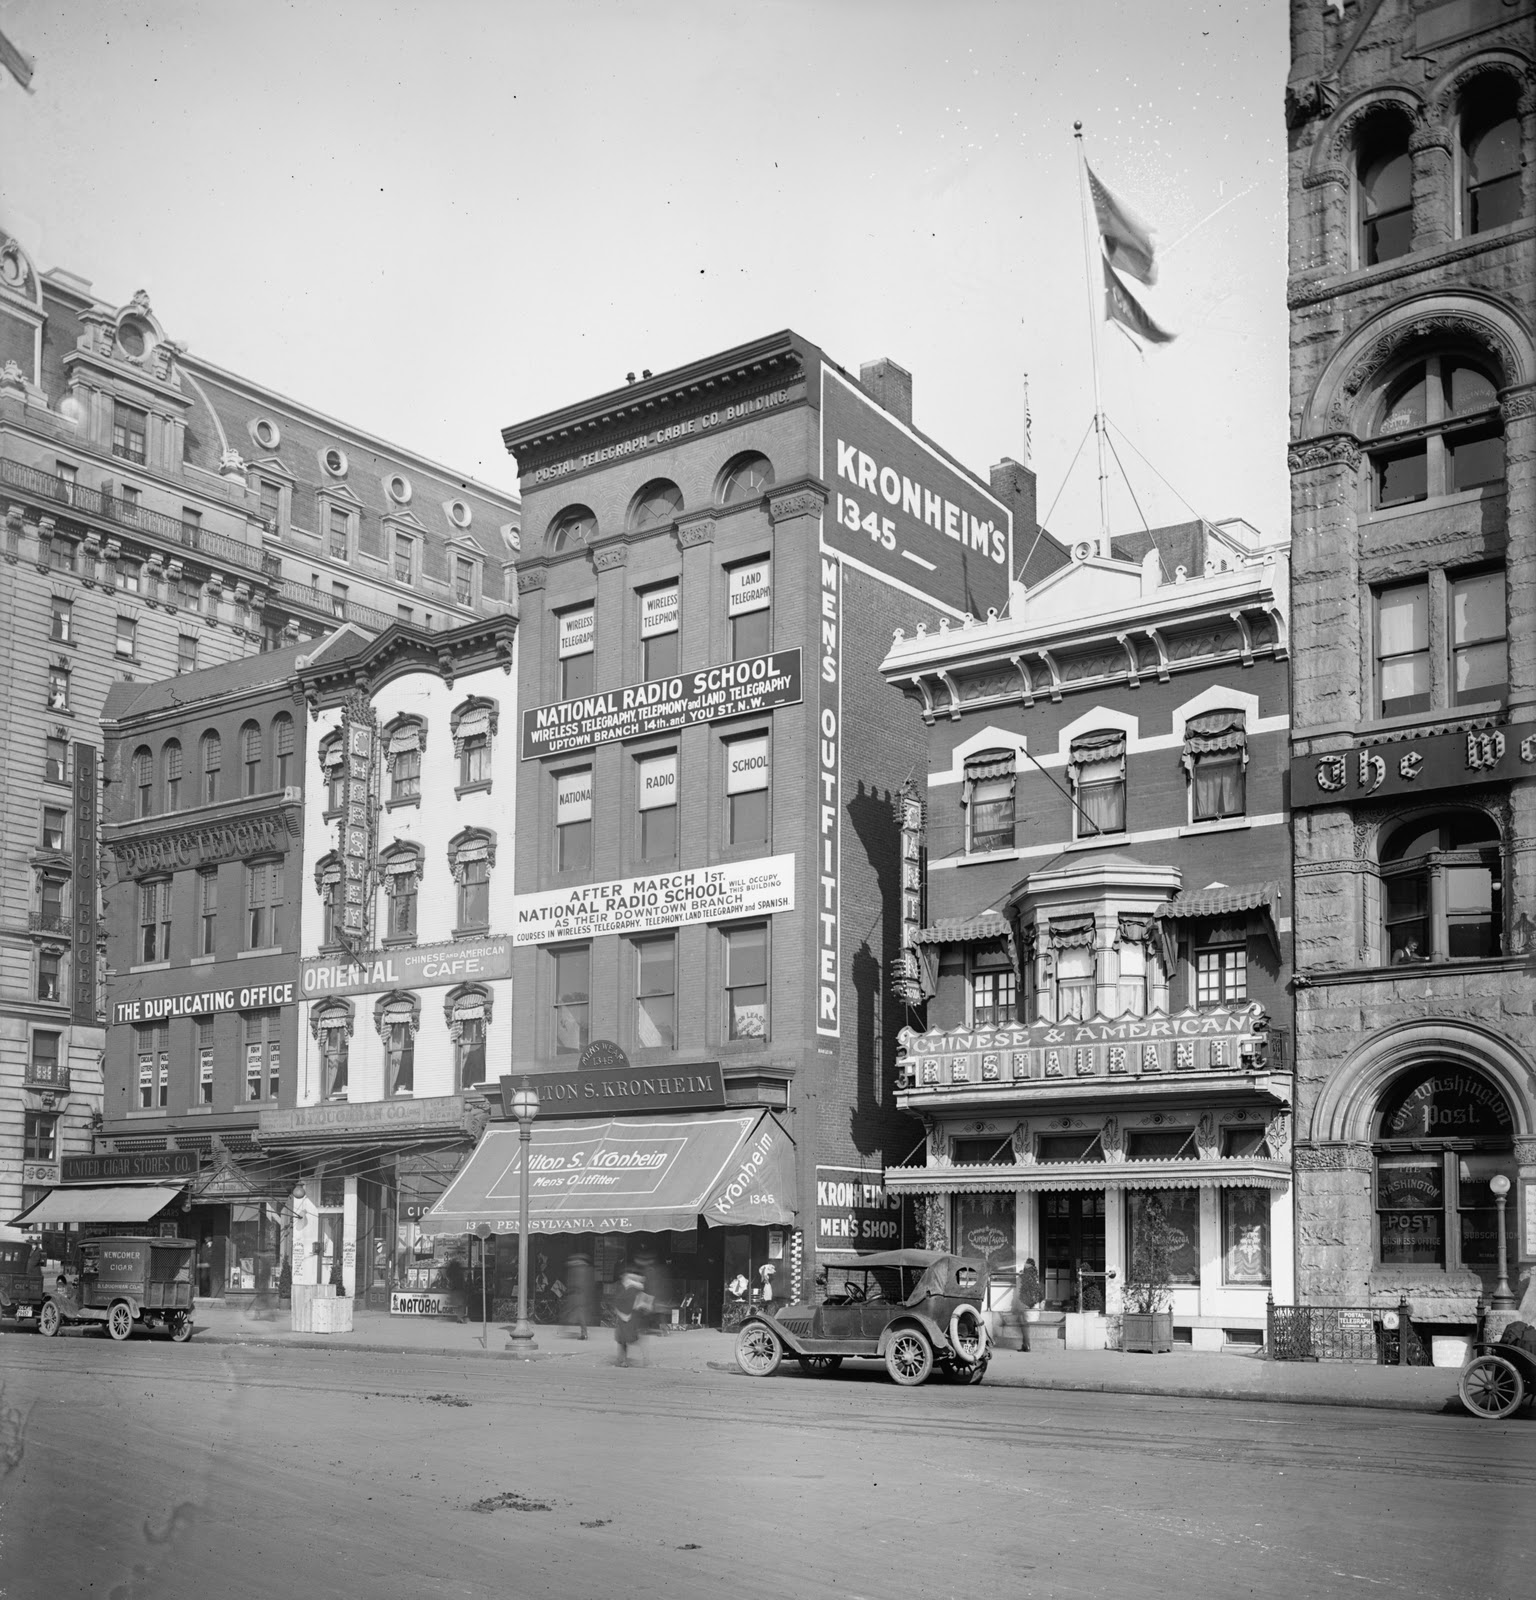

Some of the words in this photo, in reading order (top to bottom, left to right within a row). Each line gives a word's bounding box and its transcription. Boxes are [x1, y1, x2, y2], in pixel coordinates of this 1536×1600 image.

[535, 459, 576, 484] POSTAL
[702, 411, 721, 428] CO.
[837, 438, 1006, 564] KRONHEIM'S
[837, 492, 896, 550] 1345
[741, 571, 761, 588] LAND
[647, 593, 678, 611] WIRELESS
[566, 615, 593, 632] WIRELESS
[821, 558, 837, 682] MEN'S
[536, 695, 617, 729] NATIONAL
[623, 679, 683, 710] RADIO
[693, 656, 781, 694] SCHOOL
[531, 723, 578, 744] WIRELESS
[637, 698, 688, 722] TELEPHONY
[688, 697, 701, 711] and
[702, 690, 725, 708] LAND
[730, 675, 792, 701] TELEGRAPHY
[549, 733, 591, 751] UPTOWN
[594, 724, 639, 742] BRANCH
[670, 714, 686, 726] and
[690, 707, 714, 722] YOU
[718, 703, 736, 715] ST.
[737, 697, 766, 711] N.W.
[352, 730, 369, 825] CHOP
[731, 755, 768, 773] SCHOOL
[1316, 748, 1424, 795] The
[646, 773, 675, 789] RADIO
[79, 766, 91, 880] PUBLIC
[124, 838, 191, 874] PUBLIC
[197, 821, 277, 860] LEDGER
[350, 831, 365, 928] SUEY
[728, 878, 746, 887] WILL
[749, 873, 778, 885] OCCUPY
[820, 708, 836, 1021] OUTFITTER
[518, 900, 599, 923] NATIONAL
[605, 893, 658, 912] RADIO
[664, 882, 727, 904] SCHOOL
[569, 884, 623, 903] AFTER
[633, 873, 695, 894] MARCH
[729, 885, 744, 894] THIS
[746, 880, 782, 892] BUILDING
[516, 930, 546, 942] COURSES
[547, 929, 555, 938] IN
[557, 924, 591, 937] WIRELESS
[685, 909, 701, 921] LAND
[702, 903, 743, 918] TELEGRAPHY
[744, 903, 756, 913] and
[554, 918, 569, 928] AS
[574, 912, 608, 926] THEIR
[615, 902, 687, 920] DOWNTOWN
[692, 893, 743, 910] BRANCH
[77, 890, 91, 1005] LEDGER
[404, 951, 446, 966] CHINESE
[446, 951, 459, 959] AND
[459, 945, 505, 959] AMERICAN
[304, 959, 399, 991] ORIENTAL
[422, 958, 484, 977] CAFE.
[117, 1002, 140, 1022] THE
[144, 988, 234, 1017] DUPLICATING
[240, 984, 293, 1007] OFFICE
[912, 1030, 1031, 1054] CHINESE
[1043, 1028, 1066, 1044] &
[1075, 1015, 1251, 1042] AMERICAN
[593, 1056, 614, 1066] 1345
[922, 1040, 1230, 1085] RESTAURANT
[584, 1083, 600, 1099] S.
[603, 1075, 713, 1097] KRONHEIM
[1414, 1074, 1511, 1125] Washington
[69, 1160, 99, 1176] UNITED
[103, 1158, 130, 1175] CIGAR
[134, 1156, 170, 1174] STORES
[174, 1155, 190, 1172] CO.
[592, 1149, 668, 1167] Kronheim
[714, 1131, 773, 1215] Kronheim
[533, 1176, 565, 1187] Men's
[567, 1174, 619, 1186] Outfitter
[1379, 1179, 1440, 1198] WASHINGTON
[750, 1194, 775, 1204] 1345
[600, 1216, 632, 1228] AVE.
[820, 1214, 858, 1237] MEN'S
[1388, 1215, 1435, 1228] POST
[103, 1251, 140, 1259] NEWCOMER
[1383, 1237, 1416, 1245] BUSINESS
[1417, 1237, 1440, 1245] OFFICE
[400, 1299, 443, 1314] NATURAL
